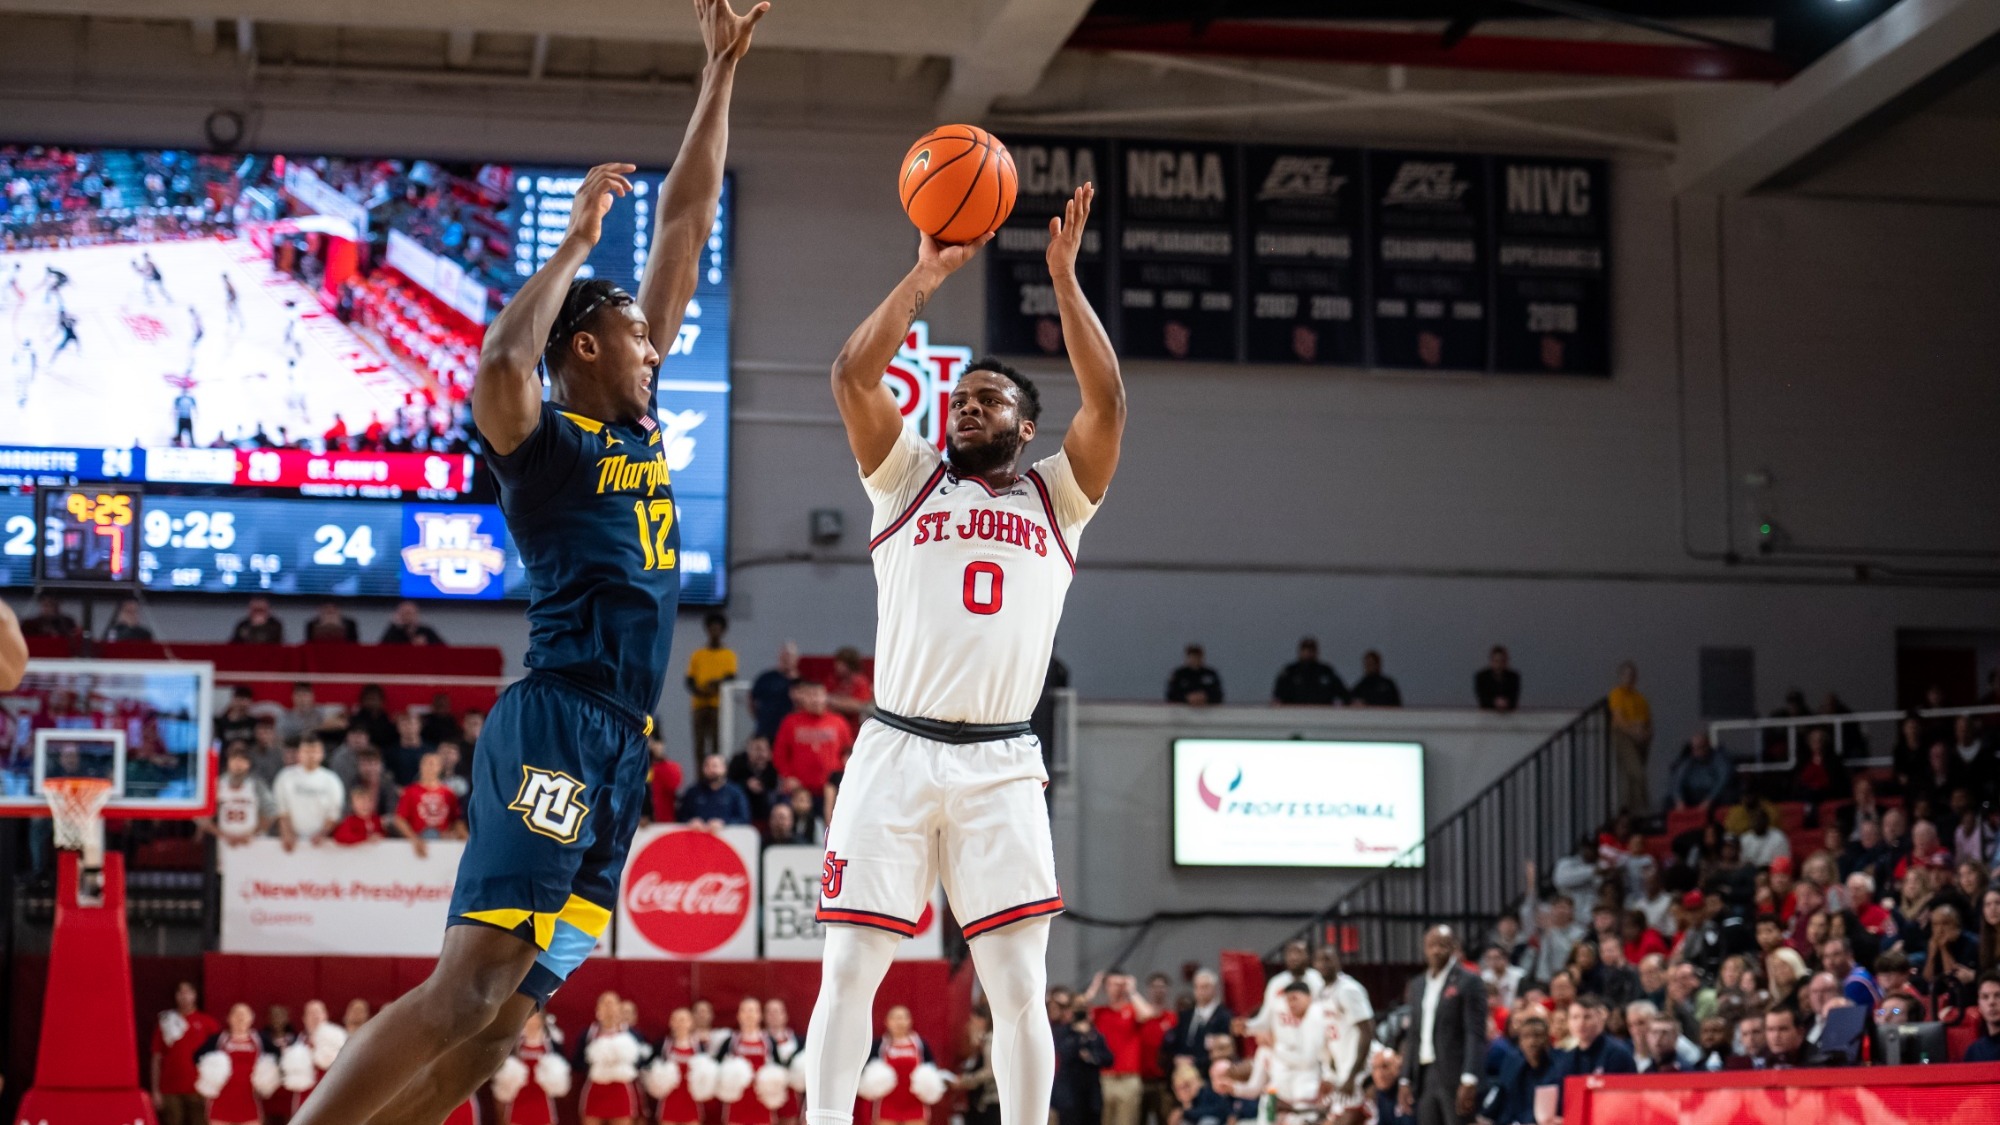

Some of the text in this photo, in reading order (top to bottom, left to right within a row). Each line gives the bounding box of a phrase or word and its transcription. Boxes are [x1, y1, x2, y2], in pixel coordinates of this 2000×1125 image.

[1127, 150, 1225, 201] NCAA
[1506, 165, 1592, 215] NIVC
[67, 493, 133, 526] 9:25
[914, 508, 1048, 557] ST. JOHN'S
[144, 509, 236, 551] 9:25
[313, 524, 376, 566] 24
[633, 499, 676, 570] 12
[963, 560, 1004, 615] 0
[508, 764, 590, 844] MU
[1228, 801, 1396, 819] PROFESSIONAL
[250, 879, 453, 908] NewYork-Presbyteri
[628, 870, 747, 915] Coca-Cola
[774, 868, 822, 909] Ap
[250, 911, 314, 927] Queens
[773, 906, 826, 940] Ba
